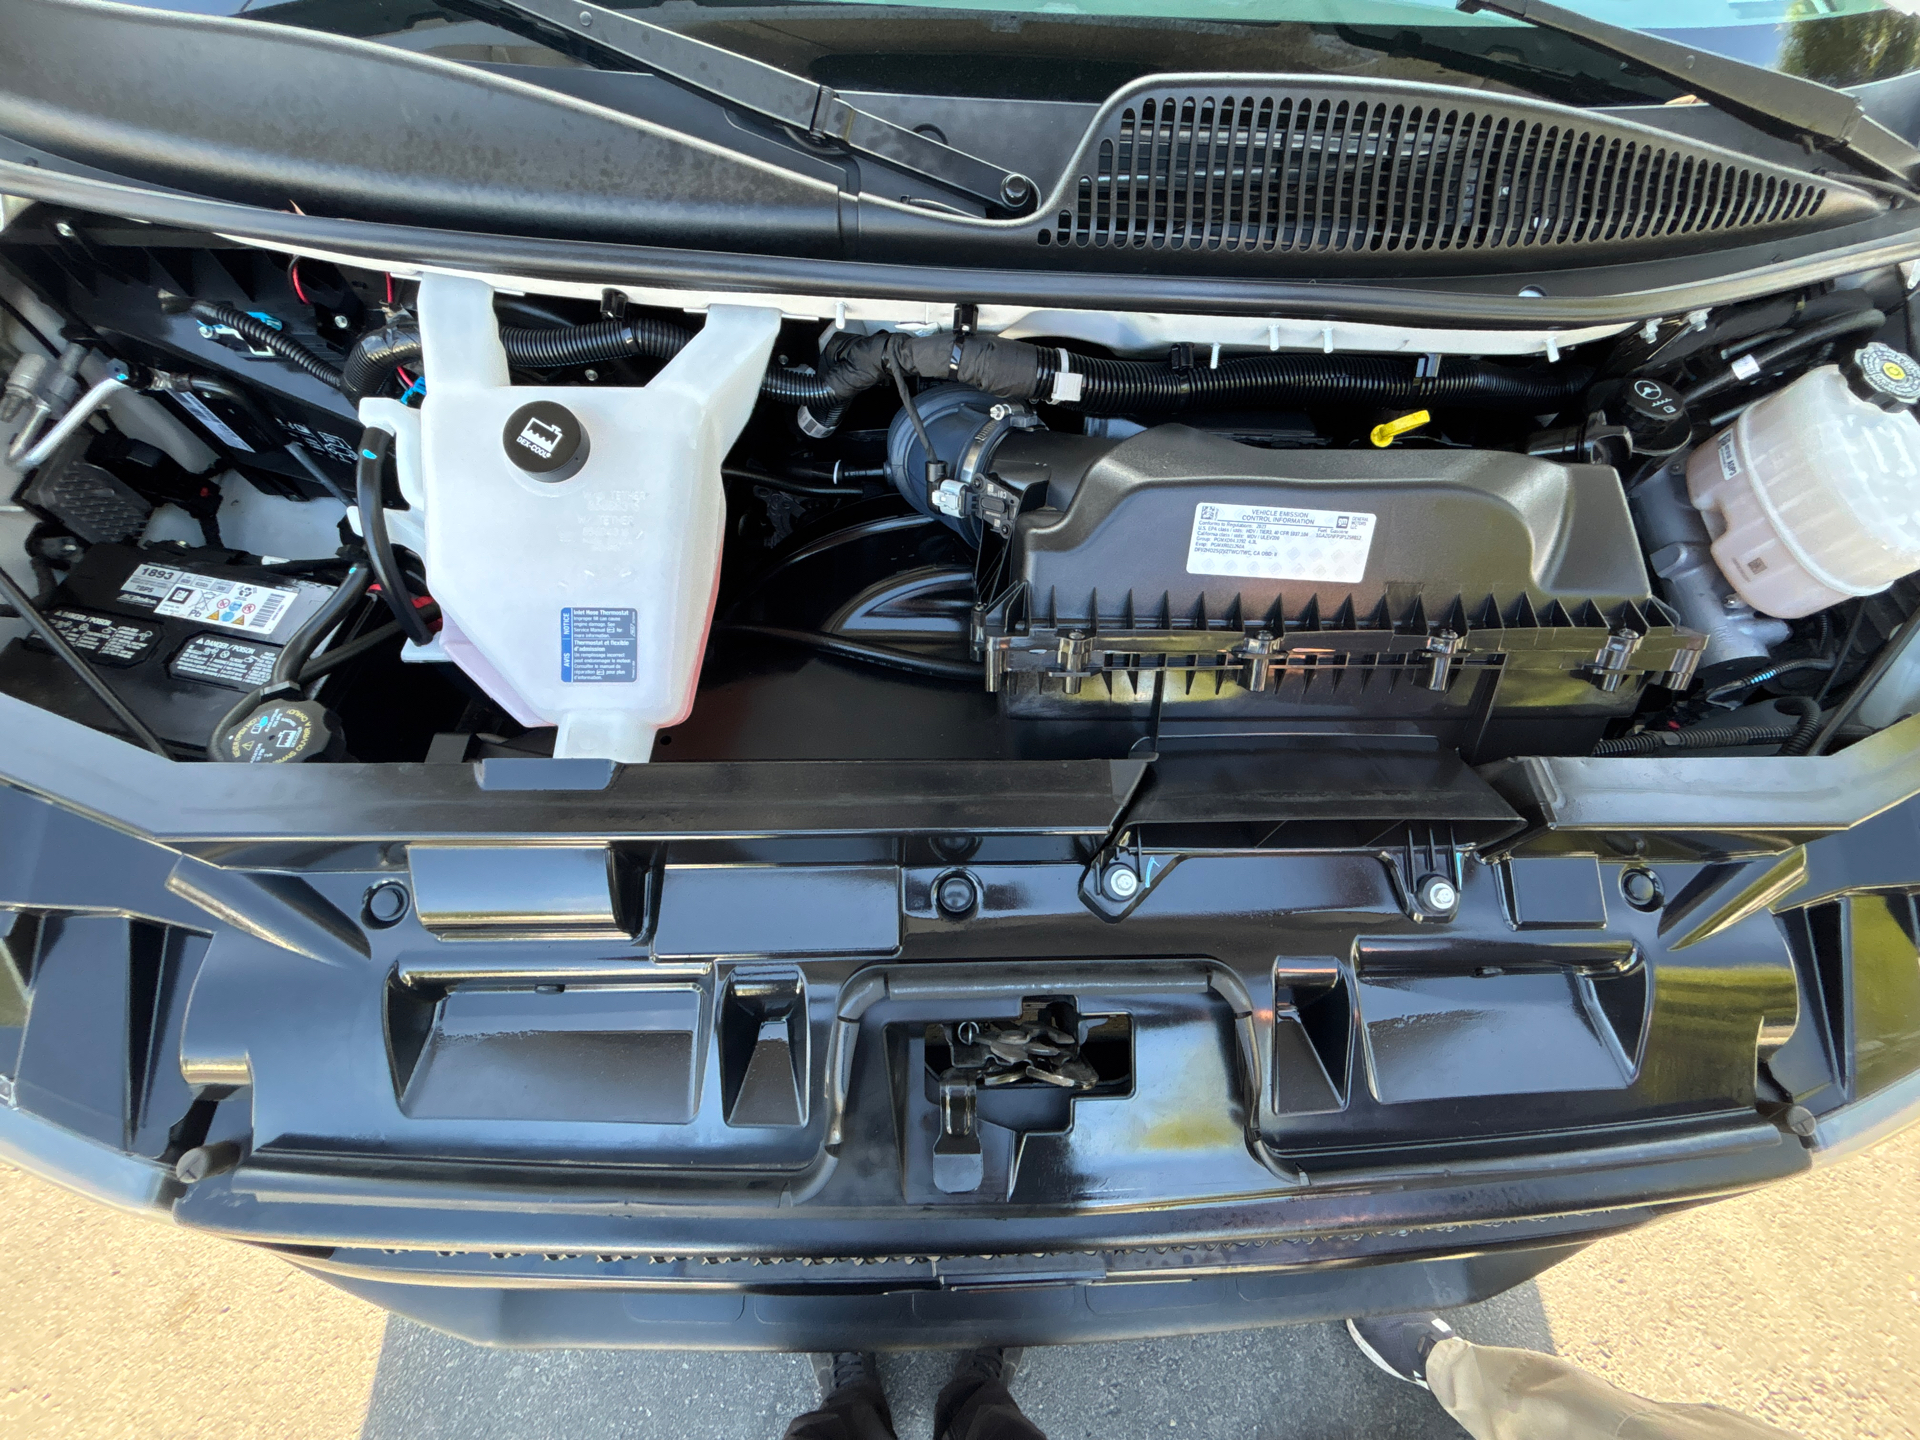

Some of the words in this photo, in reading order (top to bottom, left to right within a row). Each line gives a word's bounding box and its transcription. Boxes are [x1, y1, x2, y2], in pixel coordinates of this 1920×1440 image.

[1252, 509, 1279, 517] VEHICLE
[1273, 517, 1315, 525] INFORMATION
[141, 567, 175, 580] 1893
[189, 609, 202, 617] Pb
[234, 728, 247, 741] OPEN
[295, 727, 311, 752] OUVRIR
[232, 740, 241, 758] NEVER
